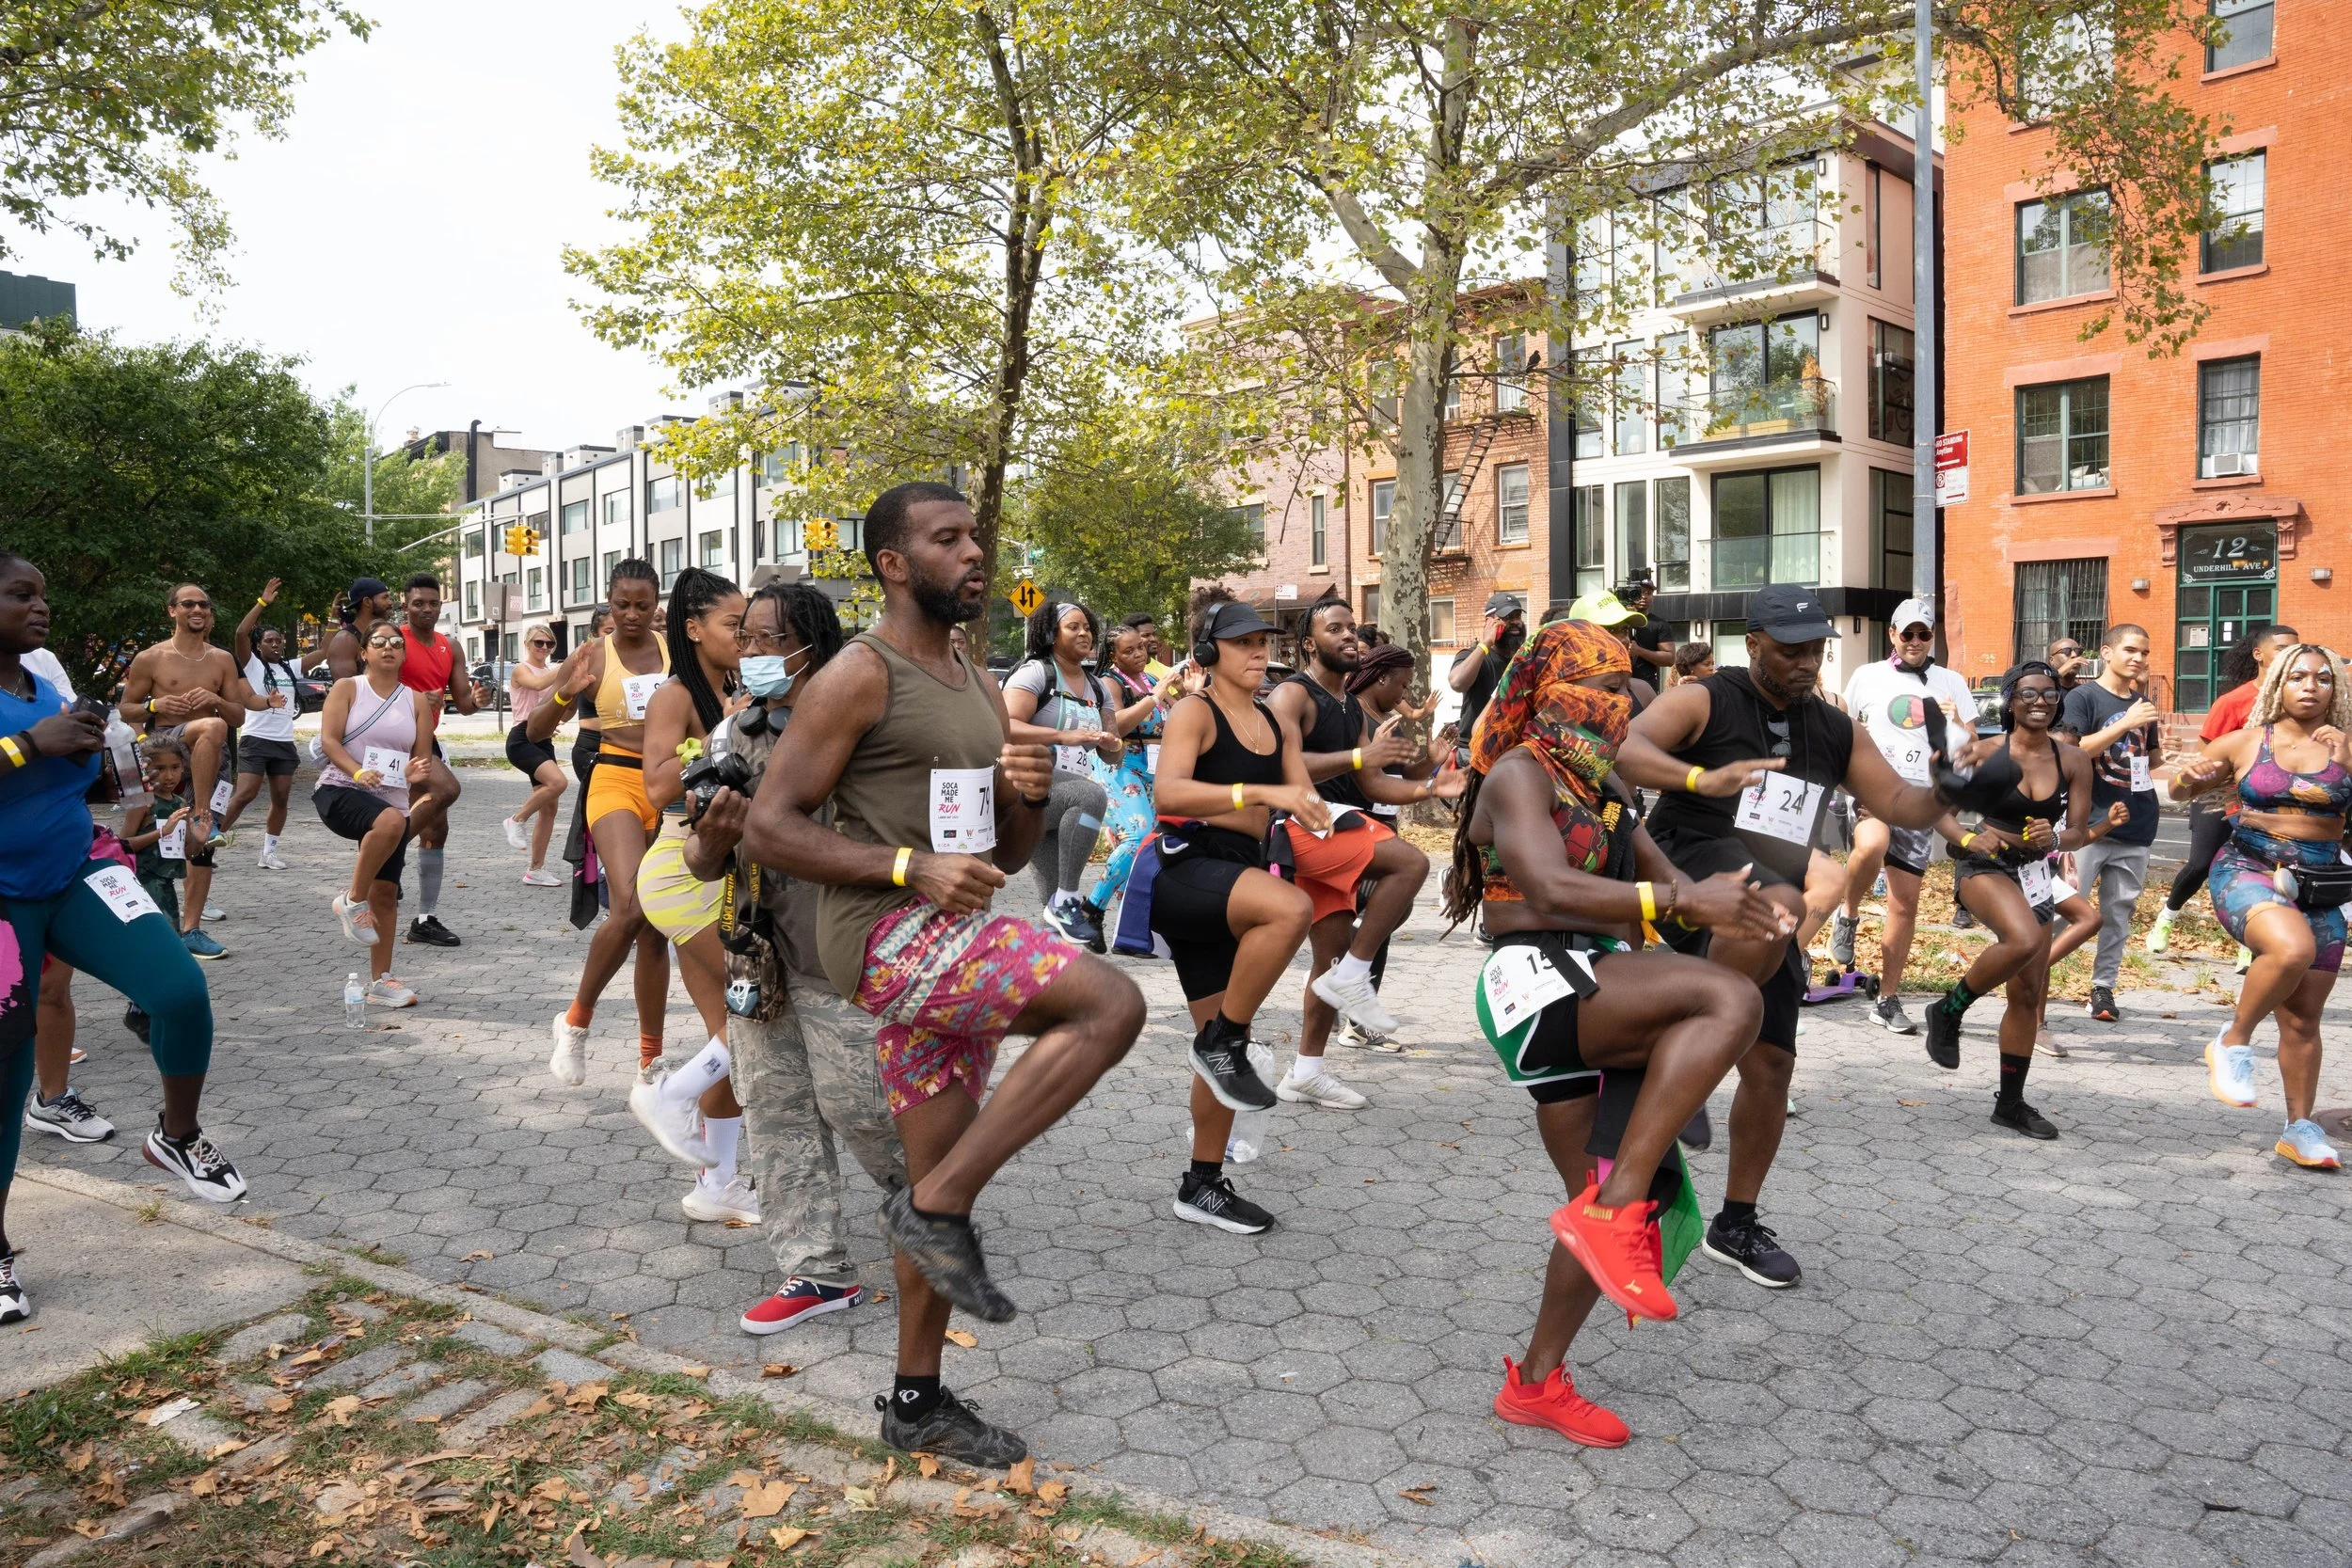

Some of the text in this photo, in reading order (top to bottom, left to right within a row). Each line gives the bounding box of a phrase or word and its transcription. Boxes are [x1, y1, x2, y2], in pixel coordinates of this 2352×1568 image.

[1943, 435, 1963, 445] STANDING
[1936, 447, 1953, 456] Anytime
[2212, 536, 2248, 559] 12
[2193, 563, 2238, 573] UNDERHILL
[1076, 752, 1088, 767] 28
[1906, 750, 1921, 763] 67
[389, 758, 400, 771] 41
[978, 785, 991, 816] 79
[1779, 789, 1803, 816] 24
[938, 803, 961, 814] RUN
[108, 885, 127, 897] RUN
[1489, 965, 1502, 976] SOCA
[1490, 970, 1502, 984] MADE
[1493, 978, 1509, 997] RUN
[1582, 1204, 1613, 1222] PUMA
